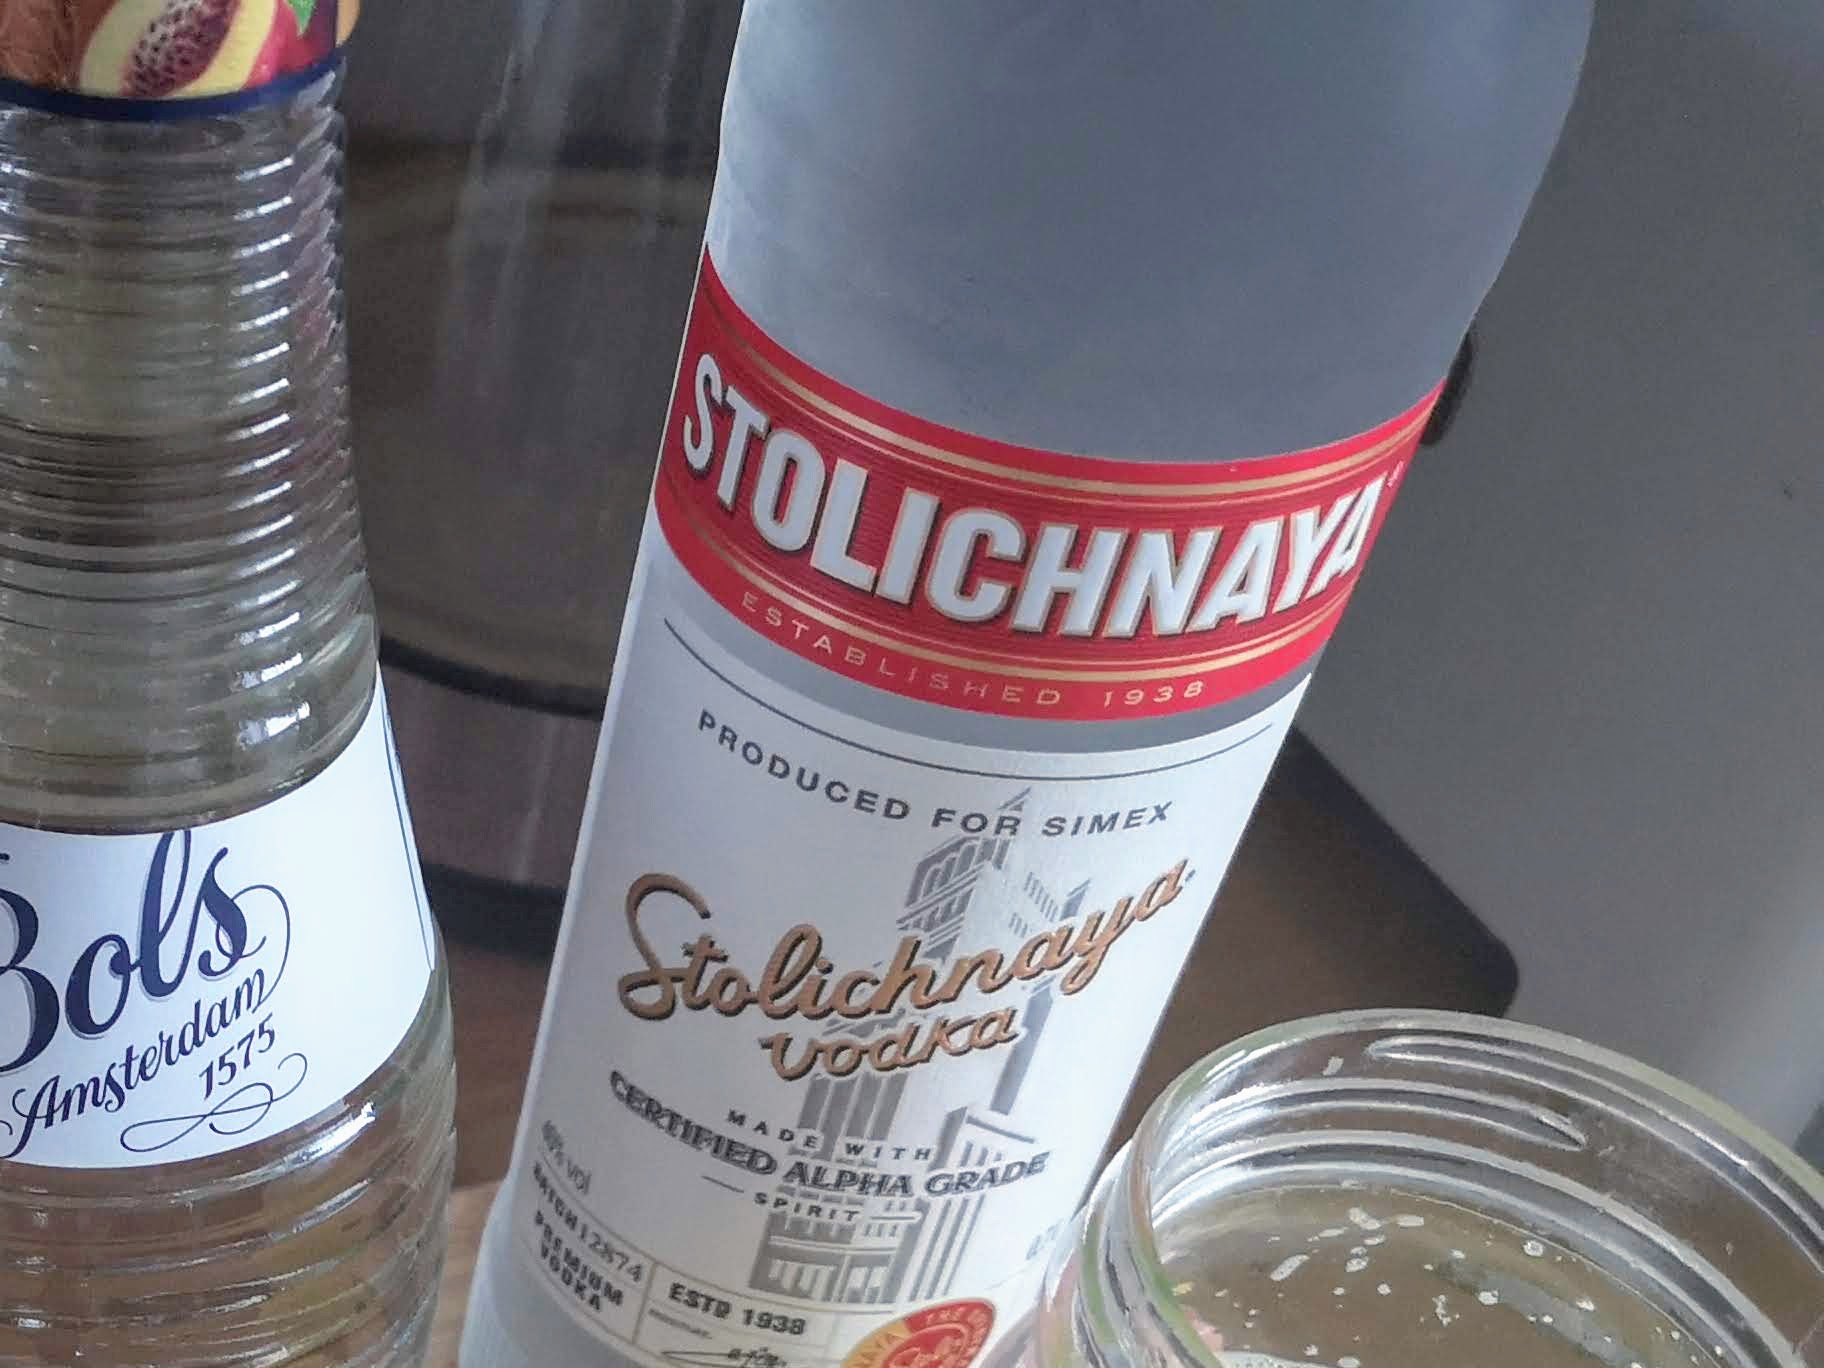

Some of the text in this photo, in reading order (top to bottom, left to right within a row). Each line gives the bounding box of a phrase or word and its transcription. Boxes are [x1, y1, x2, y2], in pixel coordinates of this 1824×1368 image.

[681, 353, 1388, 640] STOLICHNAYA
[740, 590, 1204, 708] ESTABLISHED 1938
[697, 709, 1172, 838] PRODUCED FOR SIMEX
[617, 857, 1190, 1021] Stolichnaya
[198, 1013, 277, 1100] 1575
[610, 1070, 1051, 1197] CERTIFIED ALPHA GRADE
[727, 1108, 932, 1161] MADE WITH
[754, 1191, 861, 1223] SPIRIT
[540, 1241, 602, 1311] VODKA
[743, 1308, 806, 1335] 1938
